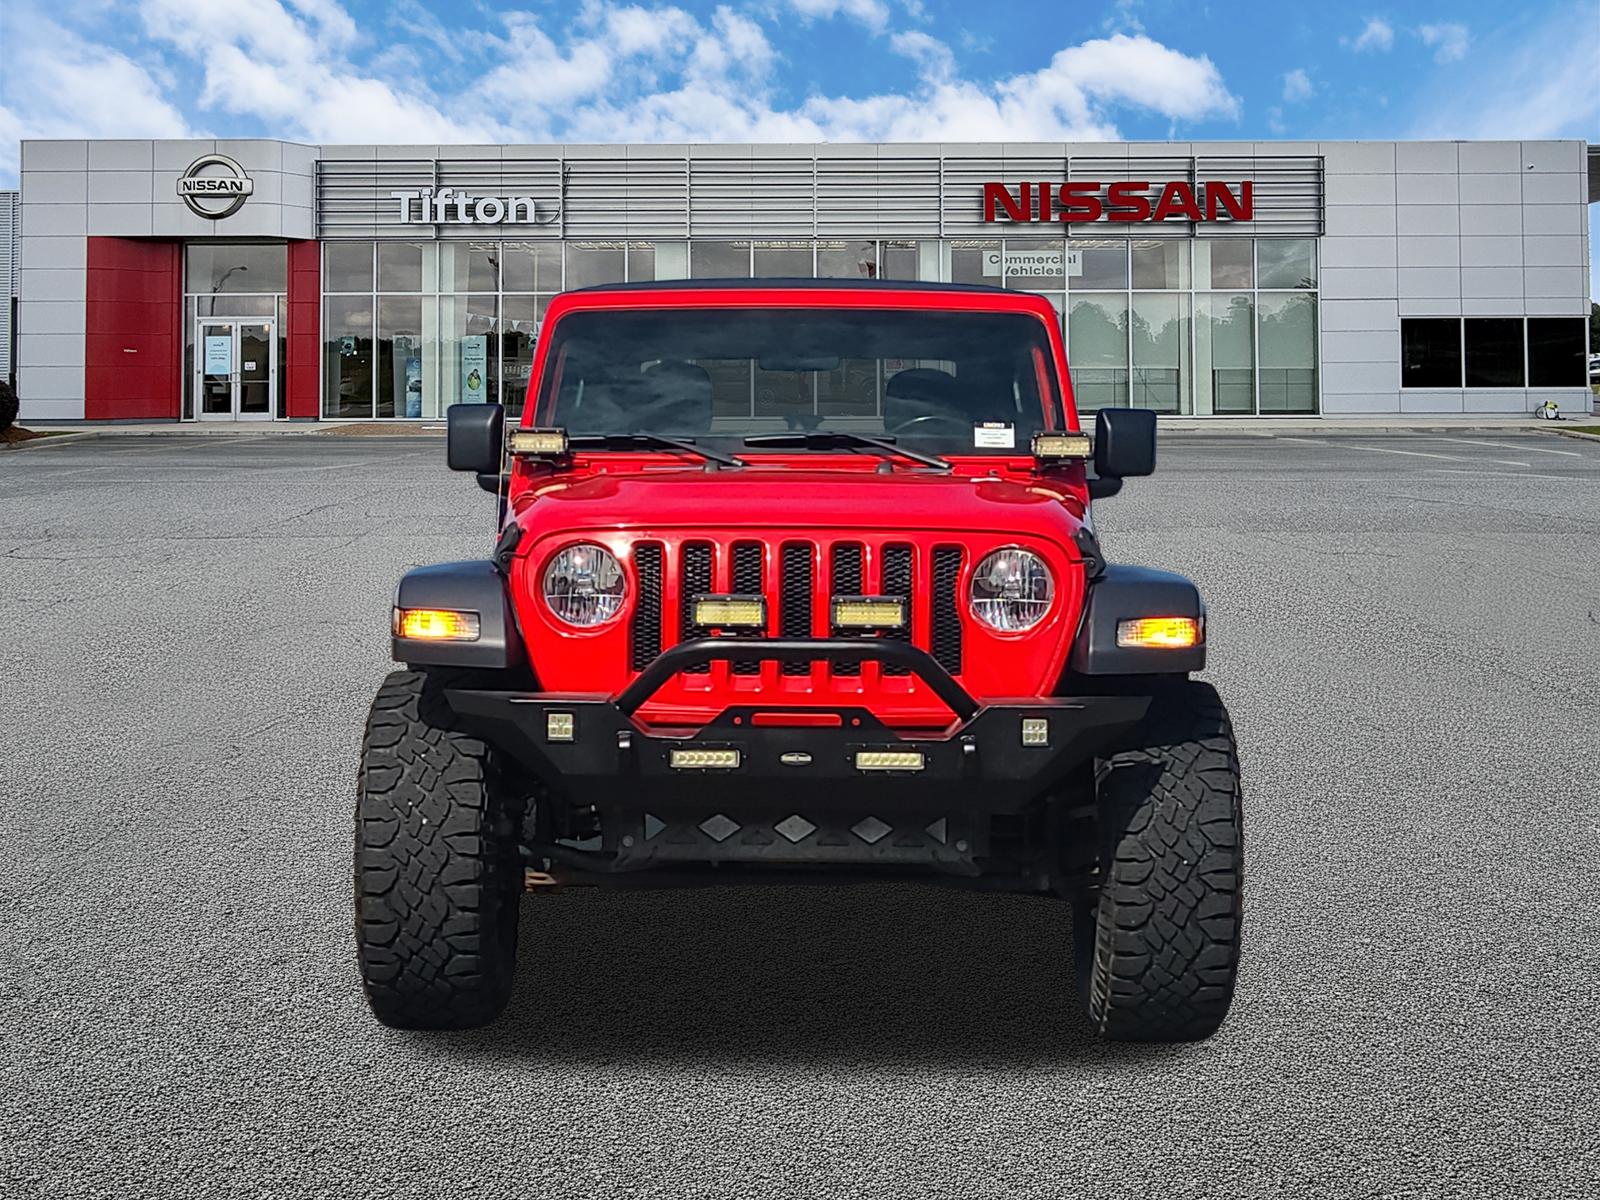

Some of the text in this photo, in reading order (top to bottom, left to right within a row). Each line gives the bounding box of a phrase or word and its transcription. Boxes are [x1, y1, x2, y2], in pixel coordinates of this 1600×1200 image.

[182, 180, 243, 192] NISSAN
[983, 181, 1253, 222] NISSAN
[391, 188, 535, 225] Tifton
